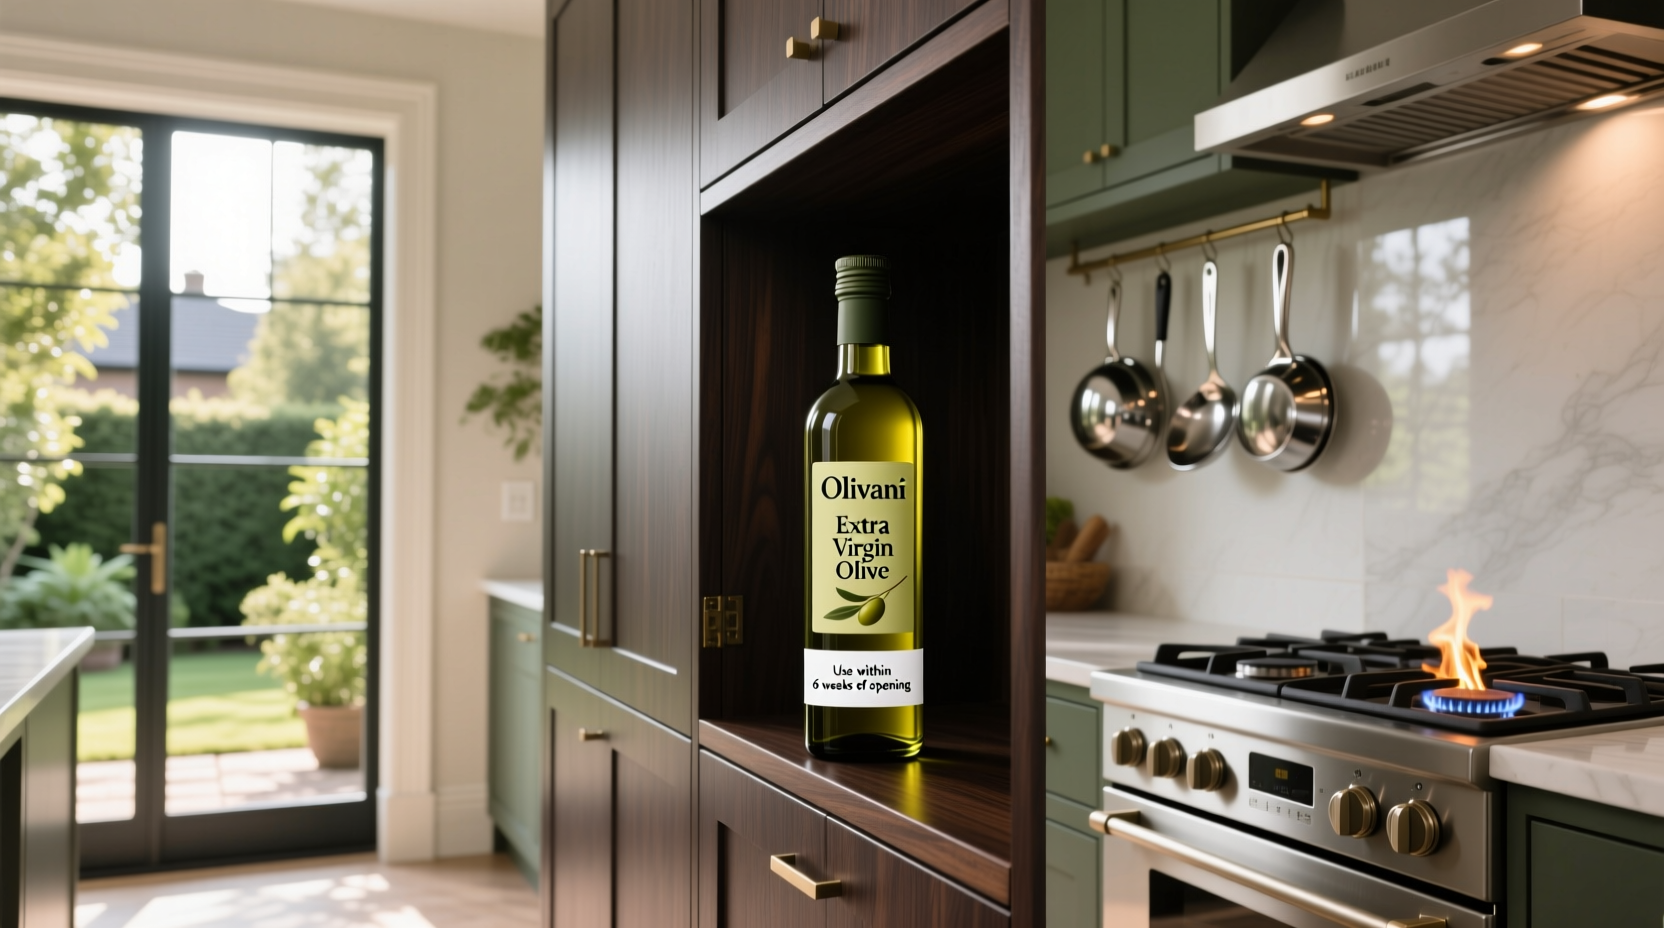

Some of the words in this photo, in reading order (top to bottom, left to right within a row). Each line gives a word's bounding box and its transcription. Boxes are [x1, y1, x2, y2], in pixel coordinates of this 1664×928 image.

[821, 475, 906, 500] Olivani
[836, 515, 890, 535] Extra
[832, 537, 894, 563] Virgin
[835, 560, 889, 580] Olive
[833, 664, 853, 676] Use
[857, 664, 892, 676] within
[812, 679, 819, 690] 6
[822, 679, 853, 691] weeks
[869, 679, 912, 694] opening
